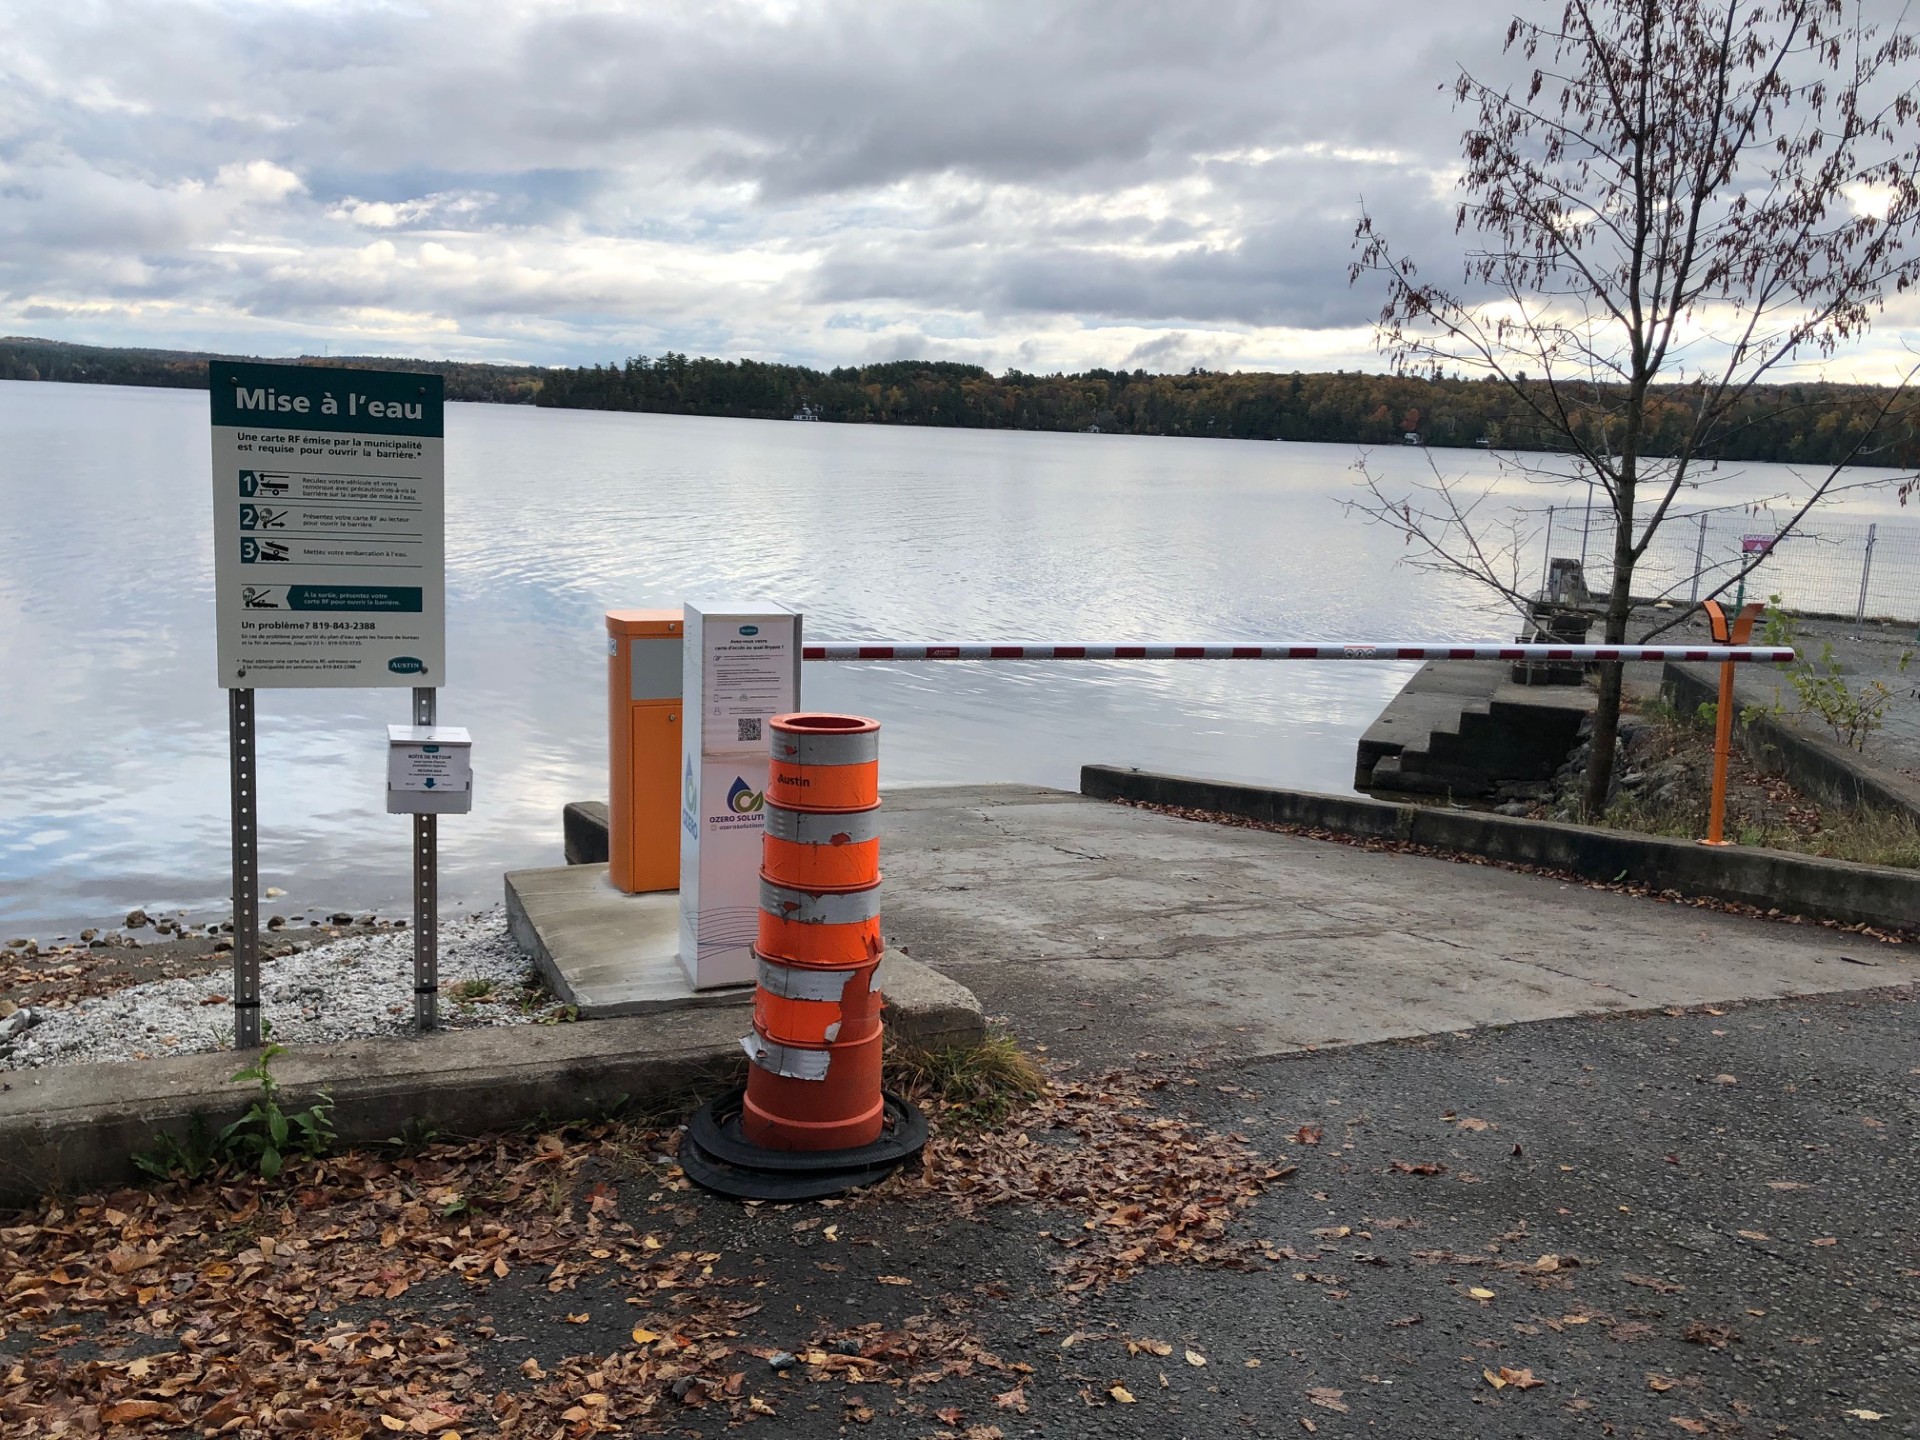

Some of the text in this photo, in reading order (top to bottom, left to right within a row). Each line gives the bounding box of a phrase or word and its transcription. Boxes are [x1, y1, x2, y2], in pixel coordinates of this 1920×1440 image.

[236, 387, 422, 420] Mise à l'eau
[237, 432, 422, 450] Une carte RF émise par la municipalité
[237, 443, 253, 451] est
[258, 445, 294, 454] requise
[300, 447, 323, 455] pour
[328, 448, 358, 456] ouvrir
[363, 449, 371, 457] la
[243, 476, 251, 491] 1
[242, 509, 254, 525] 2
[243, 542, 254, 558] 3
[258, 621, 310, 631] problème?
[312, 622, 375, 630] 819-843-2388
[778, 773, 810, 787] Austin
[709, 814, 764, 823] OZERO SOLUTI
